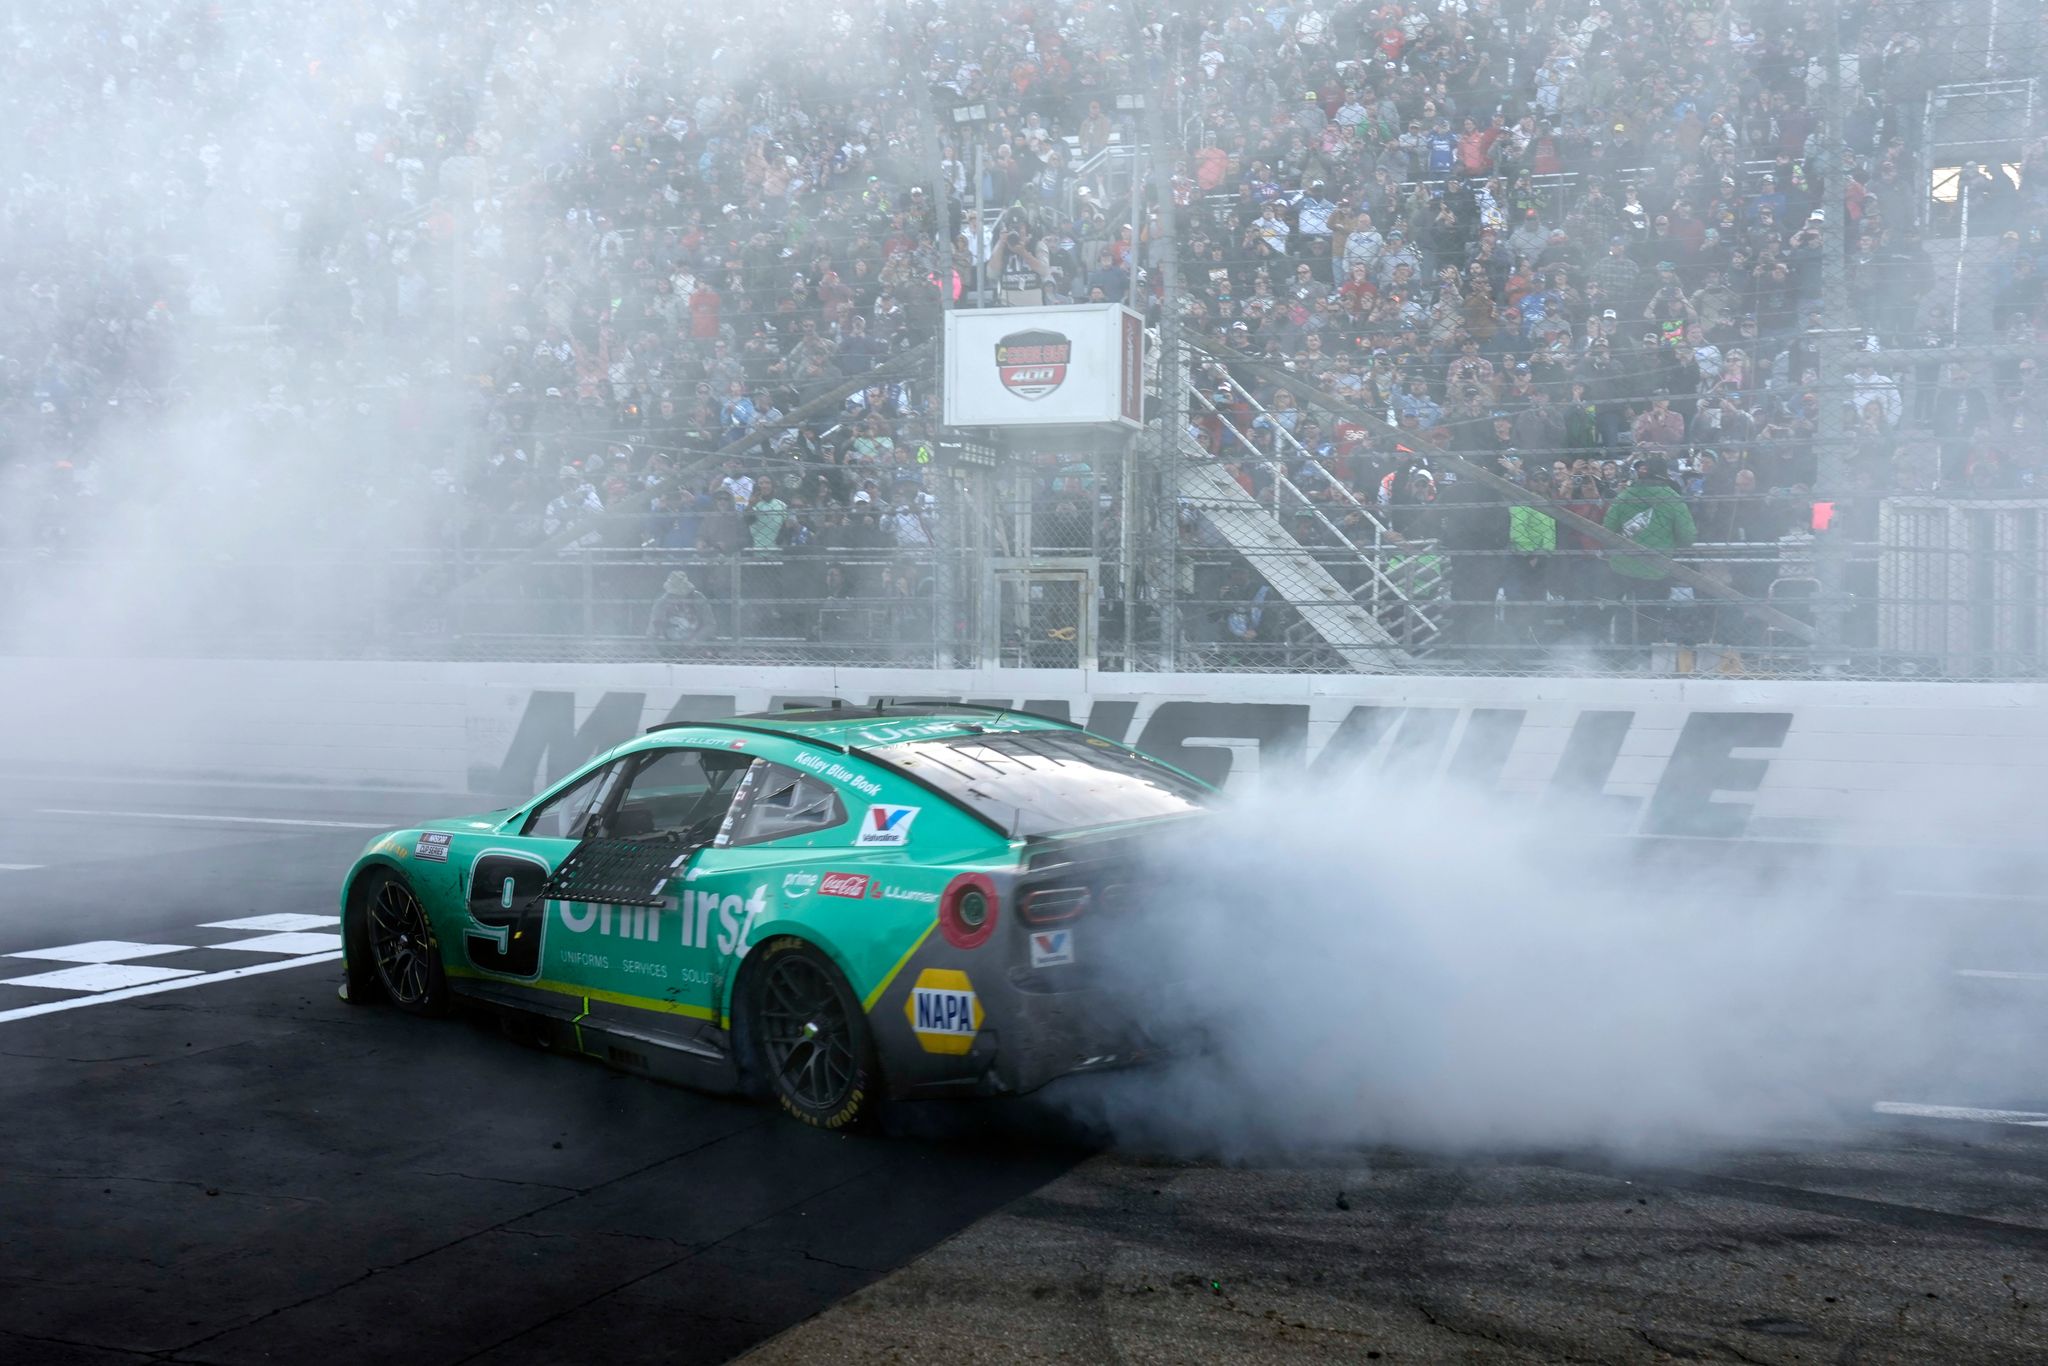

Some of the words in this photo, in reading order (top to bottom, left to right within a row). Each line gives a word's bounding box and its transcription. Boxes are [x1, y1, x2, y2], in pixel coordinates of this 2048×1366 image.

[1010, 368, 1054, 382] 400
[468, 690, 1794, 837] MSVILLE
[795, 752, 829, 773] Kelley
[827, 763, 851, 783] Blue
[850, 775, 882, 797] Book
[428, 834, 448, 844] NASCAR
[863, 833, 900, 842] Valvoline
[419, 845, 429, 853] CUP
[429, 846, 444, 855] SERIES
[783, 871, 819, 888] prime
[463, 848, 552, 984] 9
[560, 950, 609, 969] UNIFORMS
[622, 959, 668, 978] SERVICES
[918, 992, 973, 1032] NAPA
